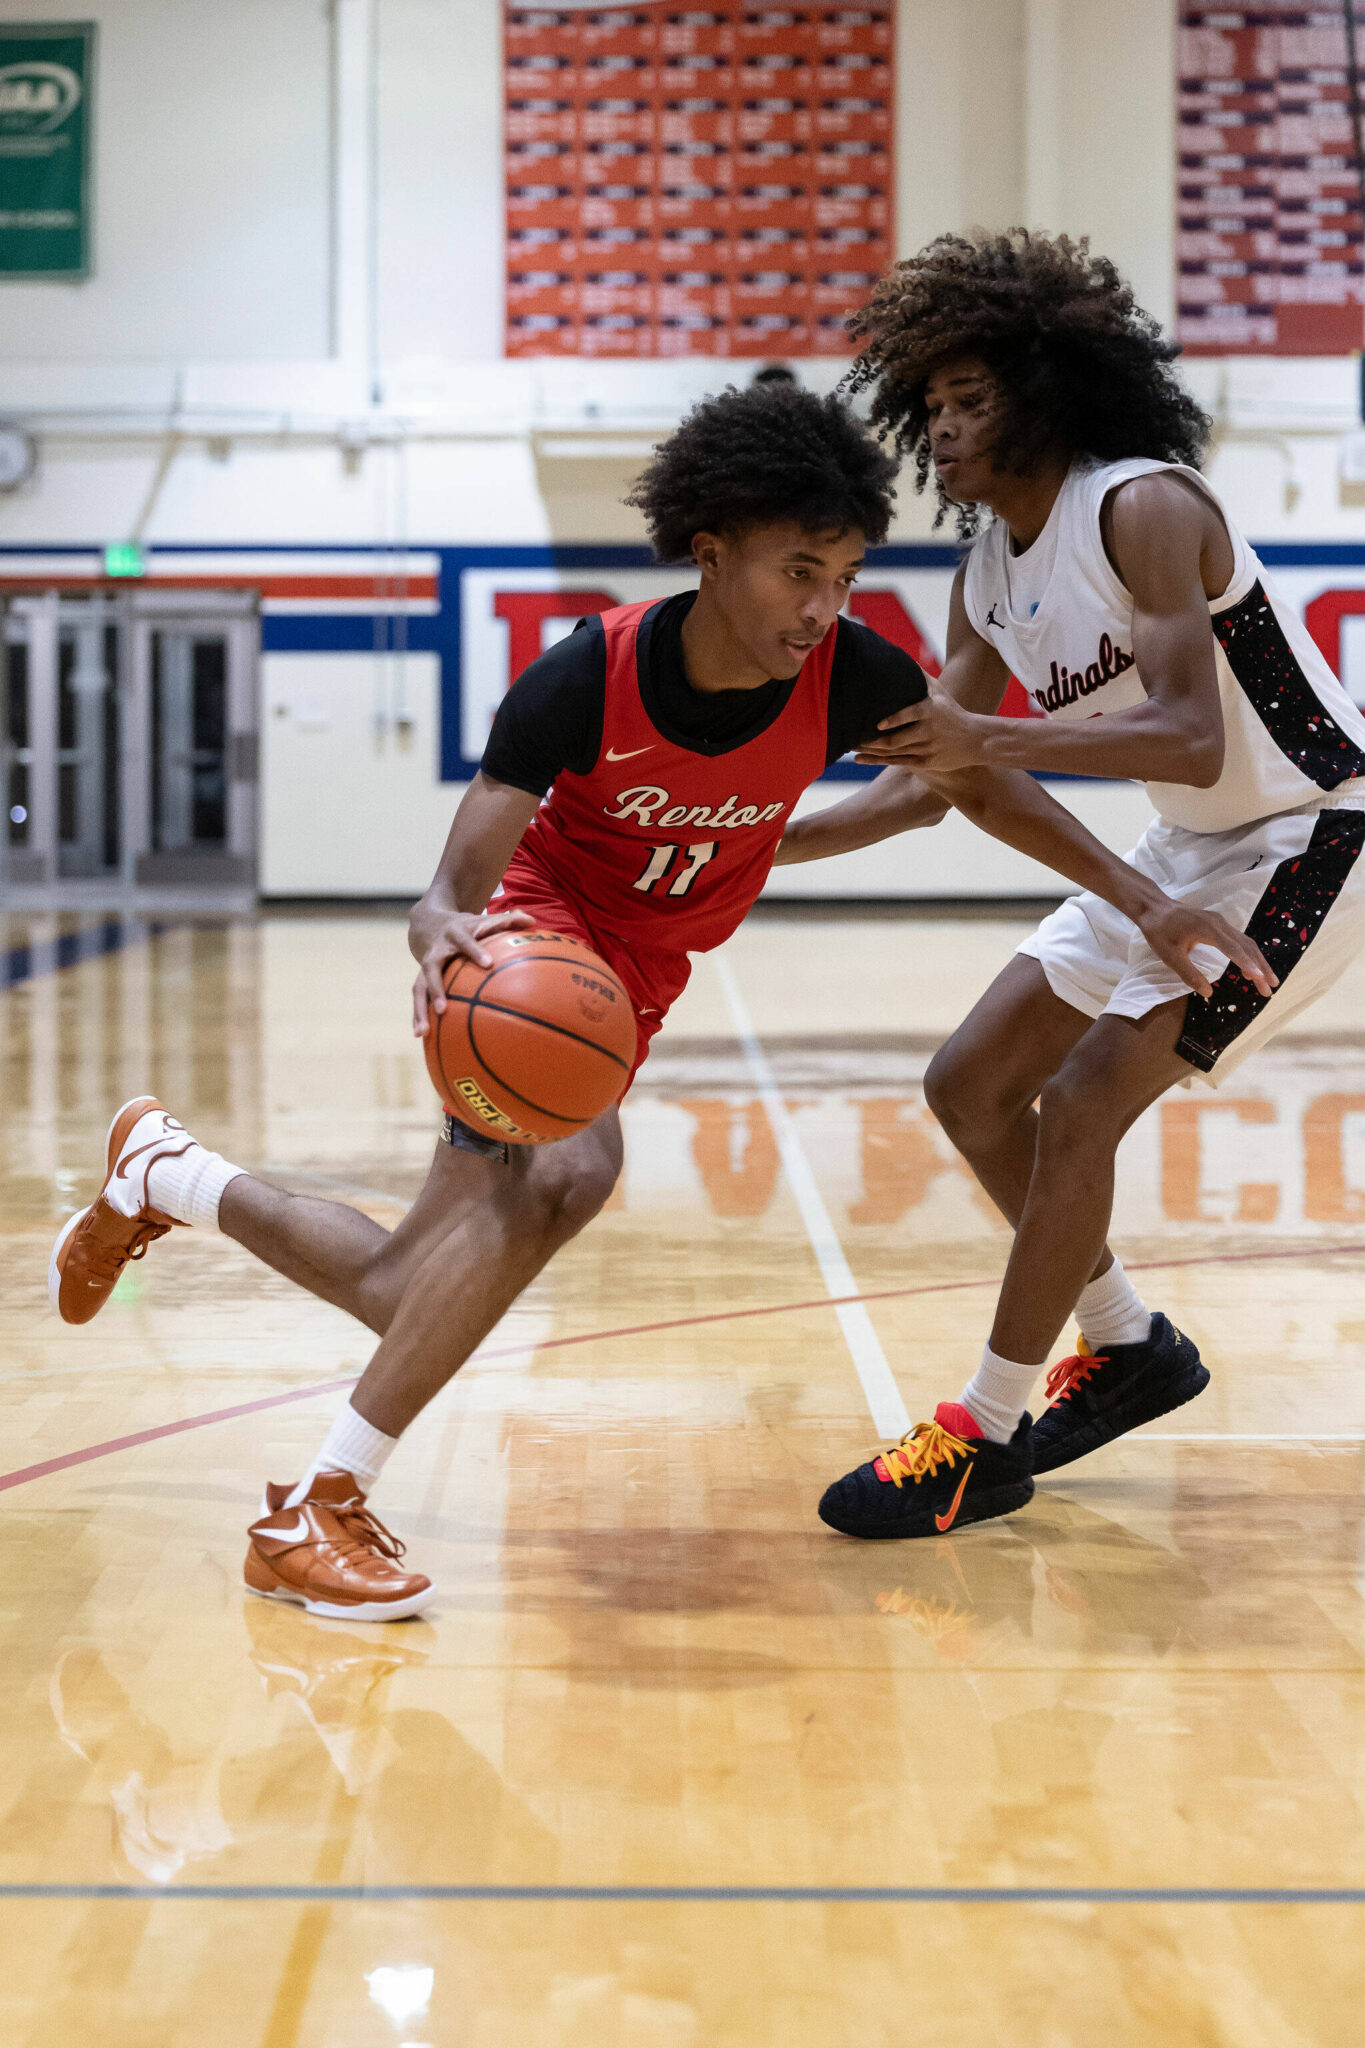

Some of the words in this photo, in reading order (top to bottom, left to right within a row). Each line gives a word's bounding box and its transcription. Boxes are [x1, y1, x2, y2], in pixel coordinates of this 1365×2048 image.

[1030, 632, 1135, 712] rdinals
[602, 785, 786, 829] Renton
[632, 841, 719, 898] 11
[459, 1080, 500, 1120] PRO
